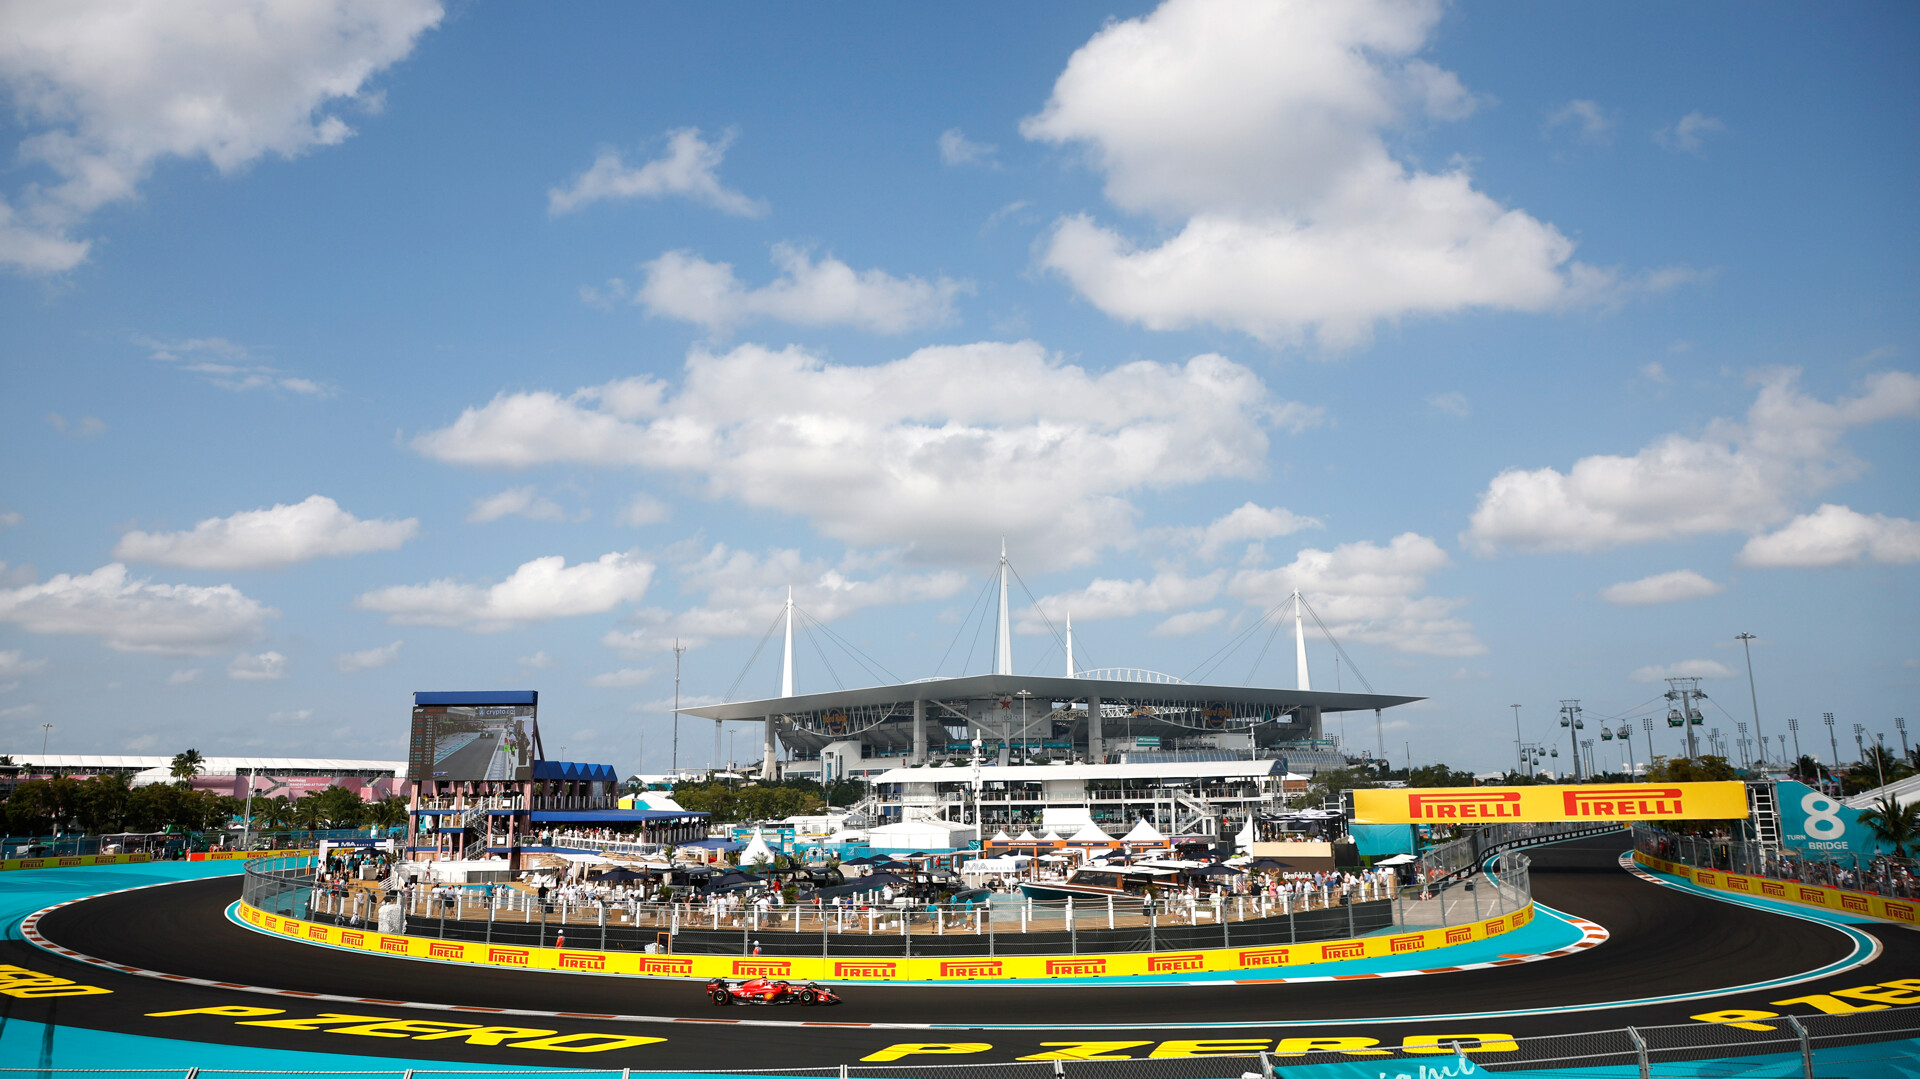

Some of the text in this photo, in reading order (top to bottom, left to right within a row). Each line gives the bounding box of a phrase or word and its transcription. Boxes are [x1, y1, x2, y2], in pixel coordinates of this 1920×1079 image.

[1408, 791, 1521, 819] PIRELLI
[1563, 788, 1683, 816] PIRELLI
[1801, 792, 1846, 841] 8
[1808, 841, 1849, 850] BRIDGE
[20, 860, 44, 868] PIRELLI
[59, 858, 81, 866] PIRELLI
[95, 856, 117, 864] PIRELLI
[129, 854, 146, 862] PIRELLI
[965, 863, 989, 871] MIA
[1697, 872, 1715, 885] PIRELLI
[1727, 877, 1749, 890] PIRELLI
[1762, 882, 1785, 897] PIRELLI
[1800, 888, 1825, 904] PIRELLI
[1841, 895, 1868, 912] PIRELLI
[1885, 902, 1915, 921] PIRELLI
[284, 921, 299, 935] PIRELLI
[309, 926, 327, 940] PIRELLI
[1486, 919, 1504, 935] PIRELLI
[341, 932, 364, 947] PIRELLI
[1390, 935, 1424, 952] PIRELLI
[1445, 927, 1471, 944] PIRELLI
[380, 937, 409, 953] PIRELLI
[429, 943, 464, 959] PIRELLI
[1321, 942, 1364, 959] PIRELLI
[489, 948, 529, 965] PIRELLI
[559, 953, 606, 970] PIRELLI
[1148, 954, 1204, 971] PIRELLI
[1239, 949, 1289, 966] PIRELLI
[640, 958, 693, 974] PIRELLI
[732, 960, 791, 976] PIRELLI
[834, 962, 897, 977] PIRELLI
[940, 961, 1003, 976] PIRELLI
[1046, 959, 1106, 975] PIRELLI
[1690, 1009, 1780, 1031] P
[144, 1005, 669, 1053] P ZERO
[860, 1033, 1520, 1062] P ZERO
